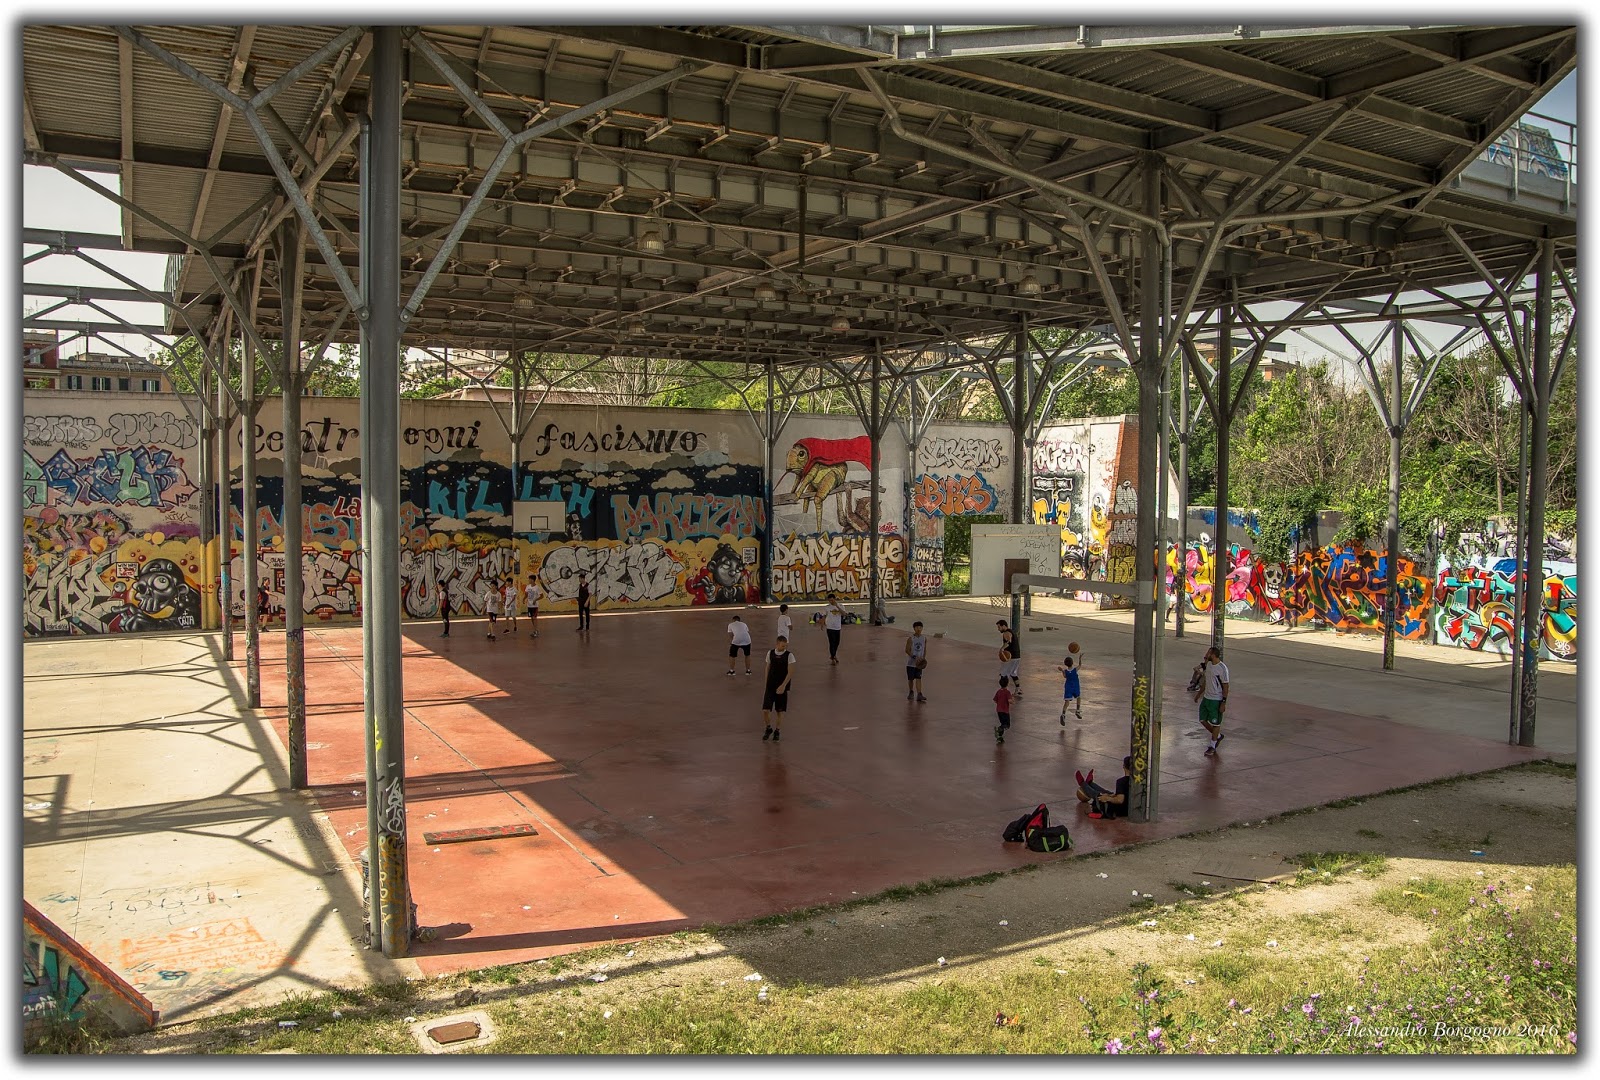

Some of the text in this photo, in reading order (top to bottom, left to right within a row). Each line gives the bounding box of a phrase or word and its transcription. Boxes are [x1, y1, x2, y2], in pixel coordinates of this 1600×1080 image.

[403, 420, 481, 454] ogni
[535, 423, 707, 456] fascismo
[805, 569, 859, 594] PENSA
